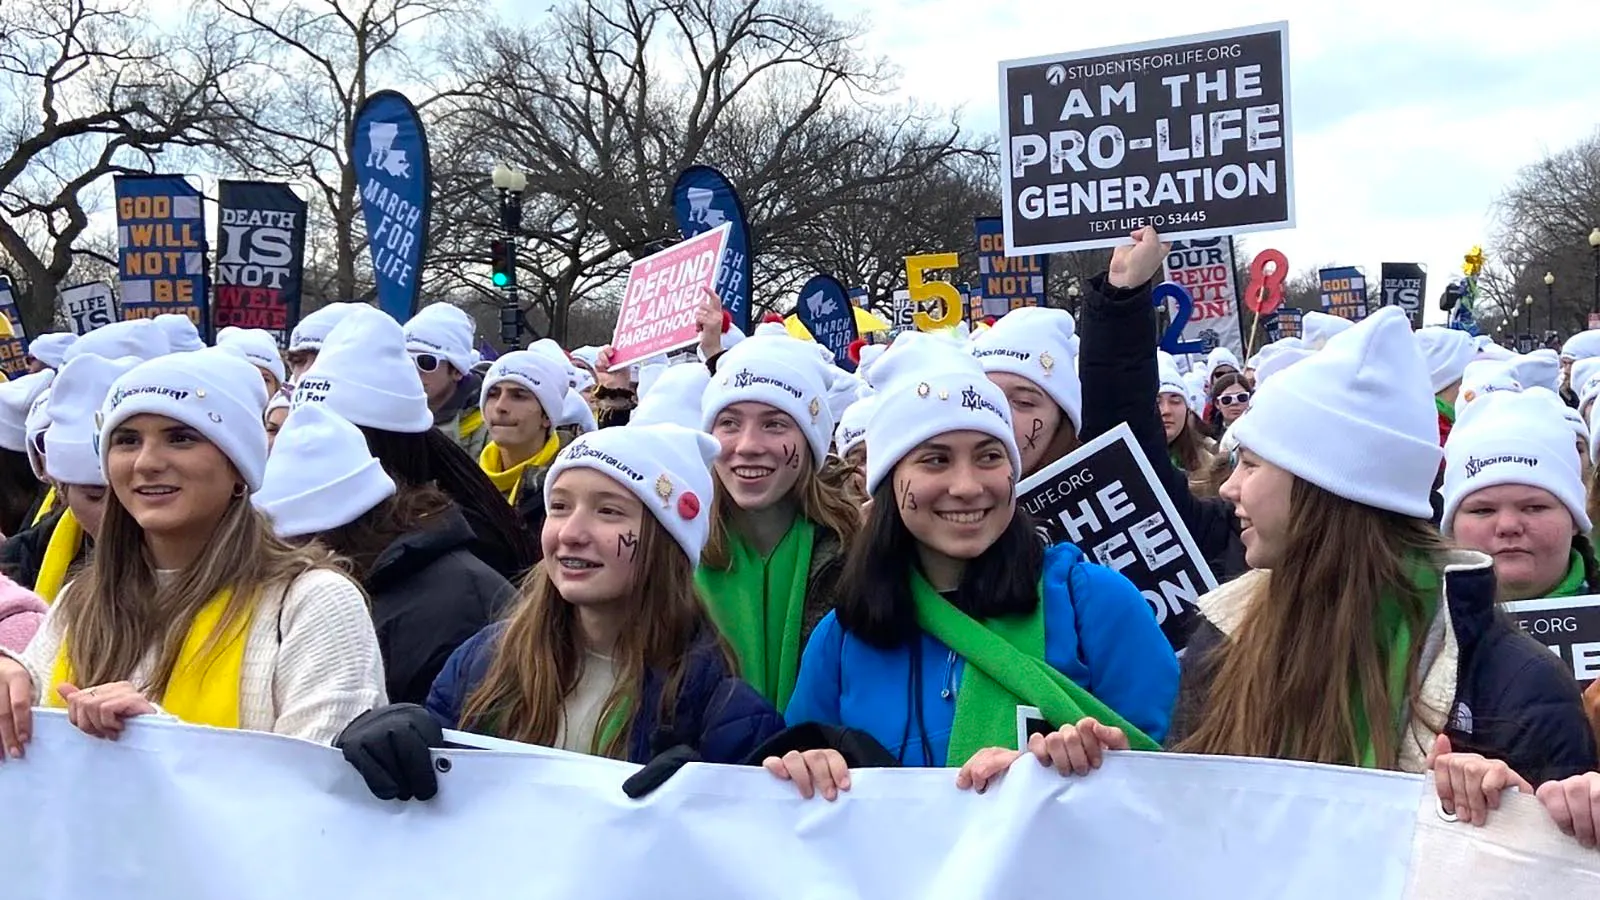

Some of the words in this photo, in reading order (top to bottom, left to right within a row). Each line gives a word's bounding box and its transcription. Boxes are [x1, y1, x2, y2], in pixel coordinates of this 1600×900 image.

[1068, 44, 1241, 80] STUDENTSFORLIFE.ORG
[1023, 94, 1034, 125] I
[1059, 81, 1137, 121] AM
[1162, 64, 1263, 108] THE
[1011, 103, 1282, 178] PRO-LIFE
[1018, 160, 1277, 220] GENERATION
[119, 196, 170, 220] GOD
[363, 177, 420, 230] MARCH
[221, 208, 296, 229] DEATH
[1089, 220, 1116, 233] TEXT
[1120, 216, 1145, 231] LIFE
[1147, 215, 1165, 228] TO
[1168, 211, 1206, 225] 53445
[130, 224, 198, 247] WILL
[219, 225, 293, 267] IS
[374, 215, 414, 259] FOR
[980, 234, 1004, 252] GO
[126, 252, 181, 276] NOT
[375, 247, 412, 287] LIFE
[991, 255, 1041, 273] WILL
[1167, 248, 1224, 270] OUR
[217, 265, 290, 289] NOT
[628, 250, 715, 307] DEFUND
[718, 265, 743, 292] OR
[988, 277, 1029, 295] NOT
[1170, 266, 1227, 287] REVO
[1245, 249, 1289, 315] 8
[1323, 279, 1350, 291] GOD
[1384, 278, 1421, 288] DEATH
[153, 280, 193, 303] BE
[217, 287, 287, 308] WEL
[719, 287, 743, 313] IFE
[905, 252, 963, 332] 5
[1189, 283, 1228, 303] UT
[1330, 292, 1364, 305] WILL
[1385, 288, 1420, 310] IS
[68, 295, 107, 314] LIFE
[622, 280, 708, 332] PLANNED
[1188, 301, 1232, 323] ON!
[71, 309, 112, 335] IS
[215, 308, 287, 329] COME
[815, 317, 851, 336] MARCH
[894, 309, 914, 326] IS
[1151, 281, 1203, 355] 2
[828, 330, 852, 349] FOR
[1006, 350, 1021, 359] LIFE
[734, 368, 770, 388] MARCH
[770, 379, 783, 388] FOR
[306, 392, 326, 402] For
[601, 454, 617, 467] FOR
[616, 462, 633, 476] LIFE
[1513, 456, 1529, 465] LIFE
[900, 480, 918, 510] 1/3
[1058, 479, 1136, 543] HE
